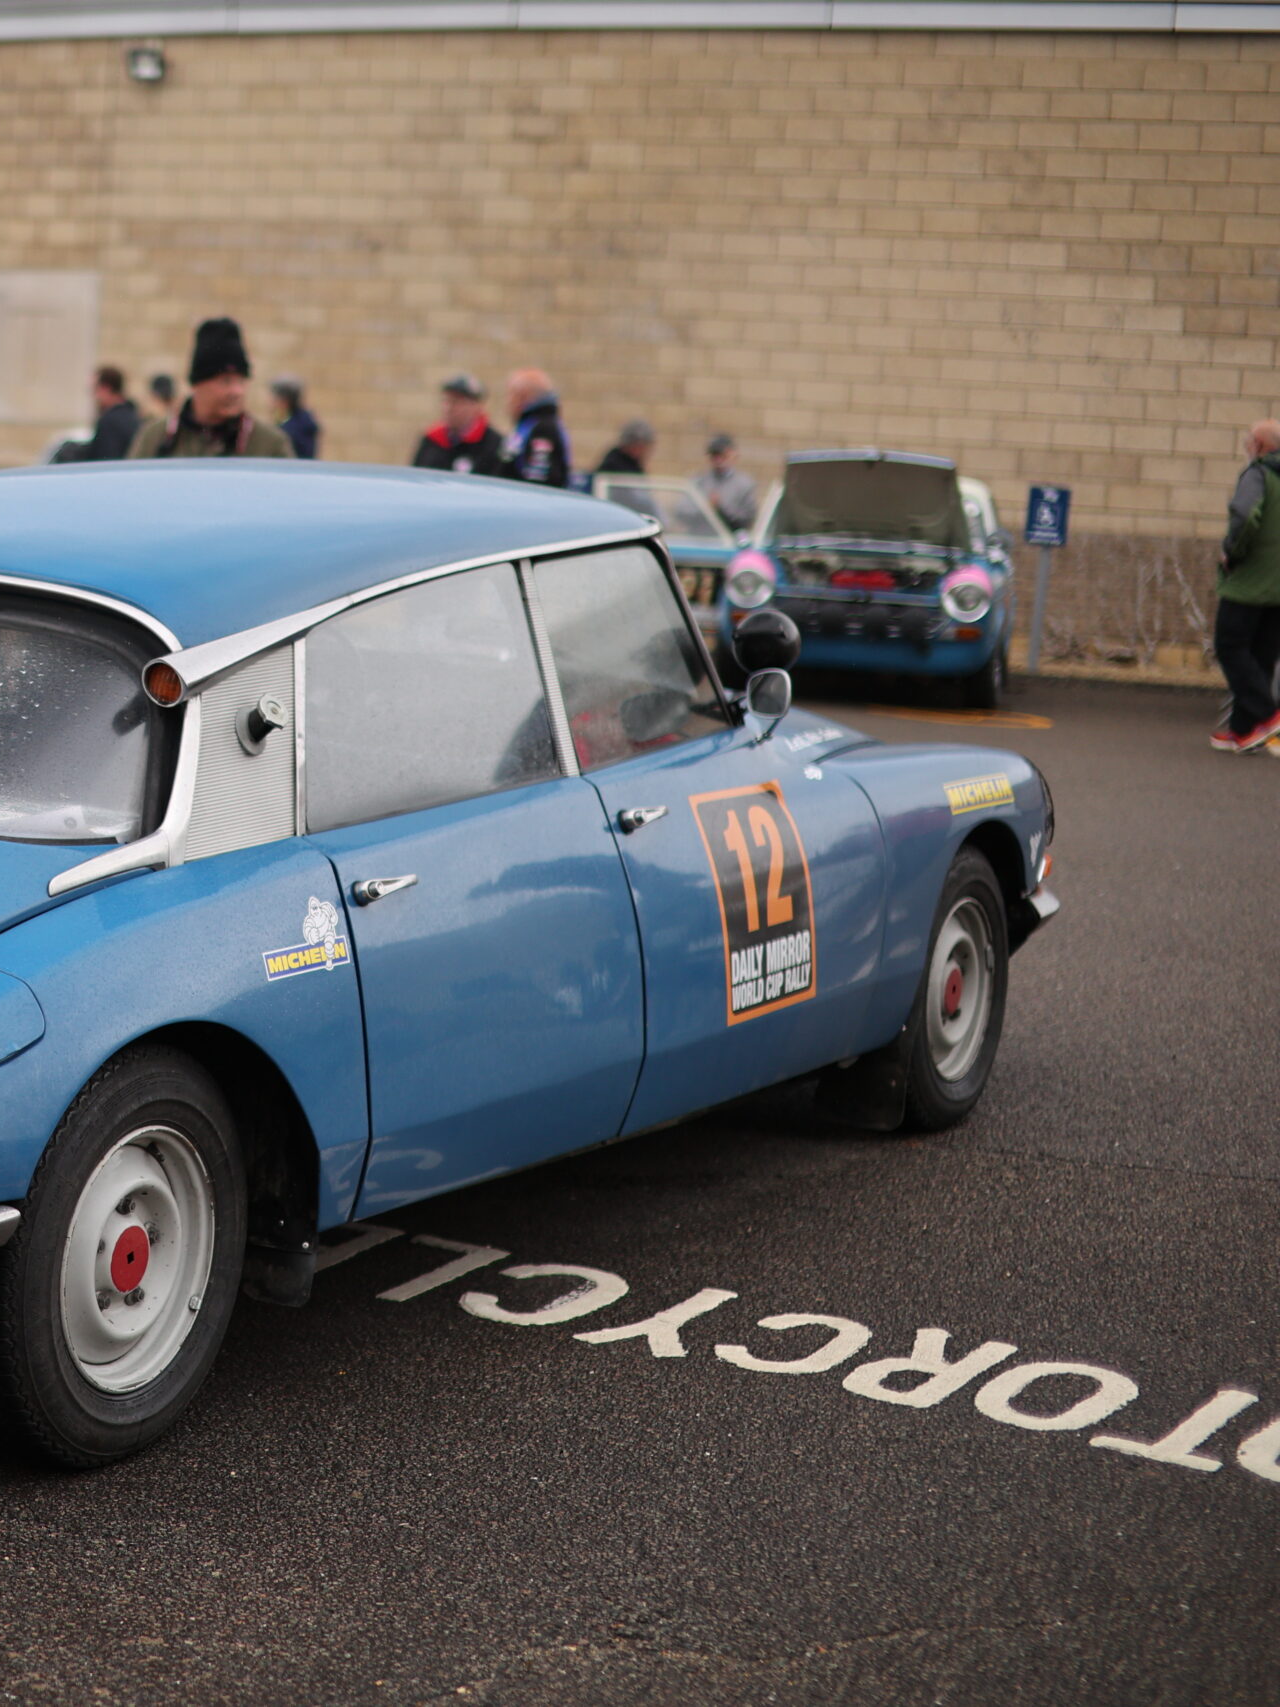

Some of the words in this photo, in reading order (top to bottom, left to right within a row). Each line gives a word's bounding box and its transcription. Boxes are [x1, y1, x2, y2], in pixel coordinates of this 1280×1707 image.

[947, 778, 1013, 810] MICHELIN
[723, 804, 794, 933] 12
[266, 941, 347, 974] MICHELN
[731, 942, 764, 985] DAILY
[765, 929, 811, 975] MIRROR
[731, 977, 764, 1012] WORLD
[765, 971, 784, 1001] CUP
[784, 962, 811, 995] RALLY
